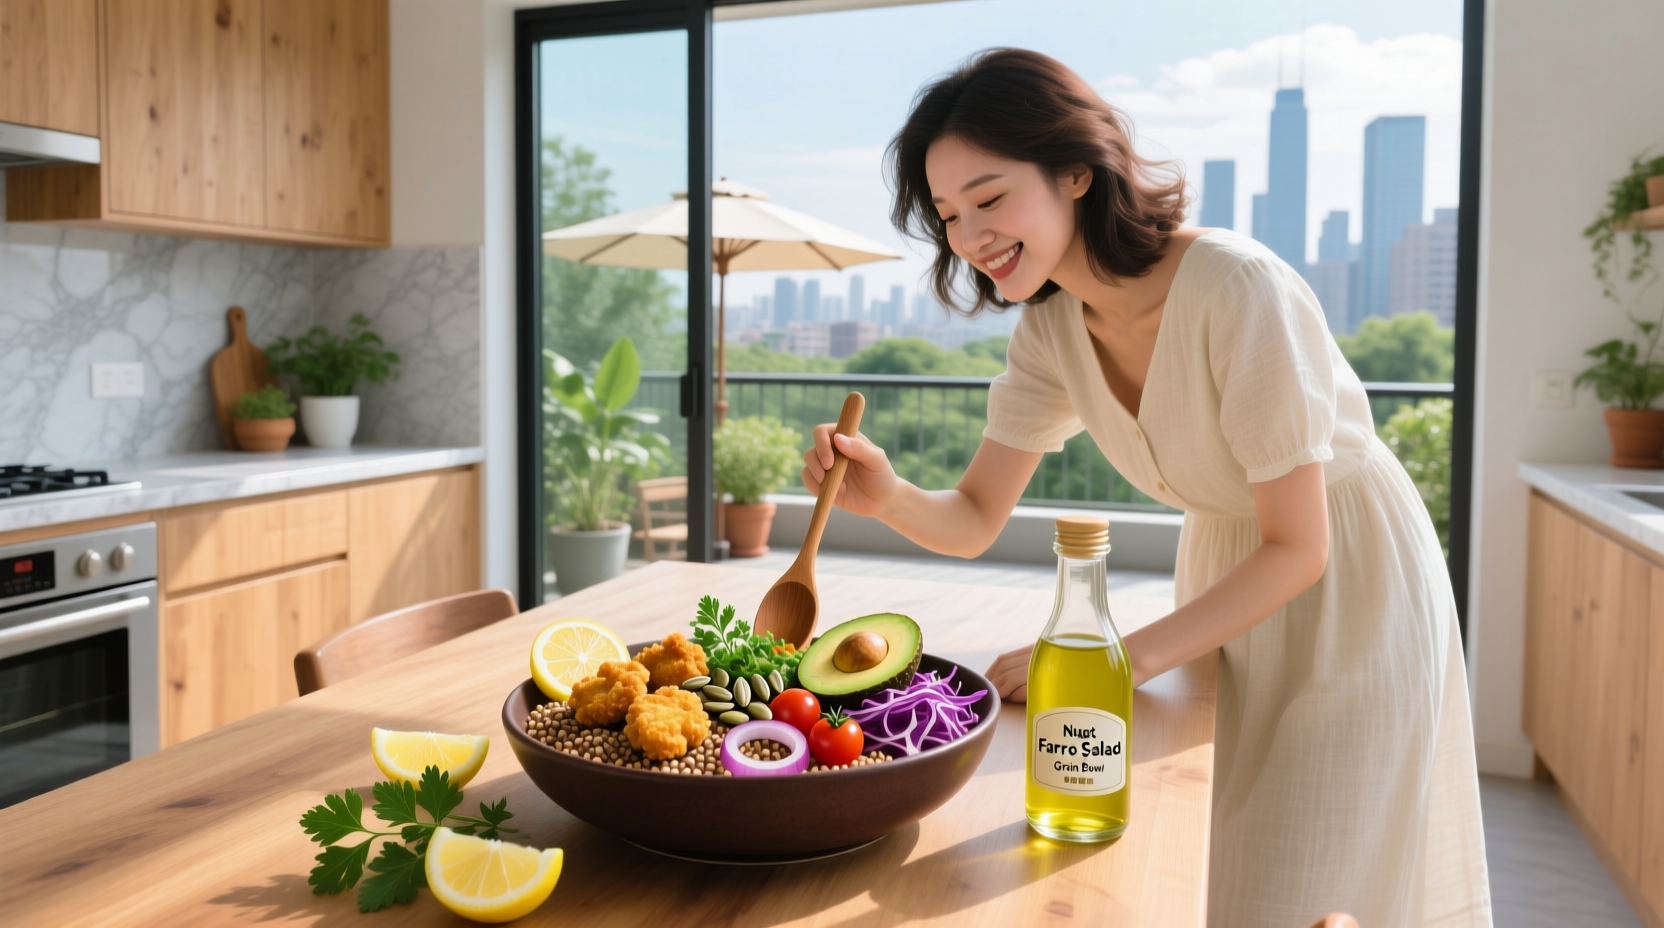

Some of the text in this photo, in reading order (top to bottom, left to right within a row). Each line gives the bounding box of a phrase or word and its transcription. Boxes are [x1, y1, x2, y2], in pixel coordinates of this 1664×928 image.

[1039, 738, 1121, 757] Farro Salad
[1053, 760, 1105, 773] Grain Bowl
